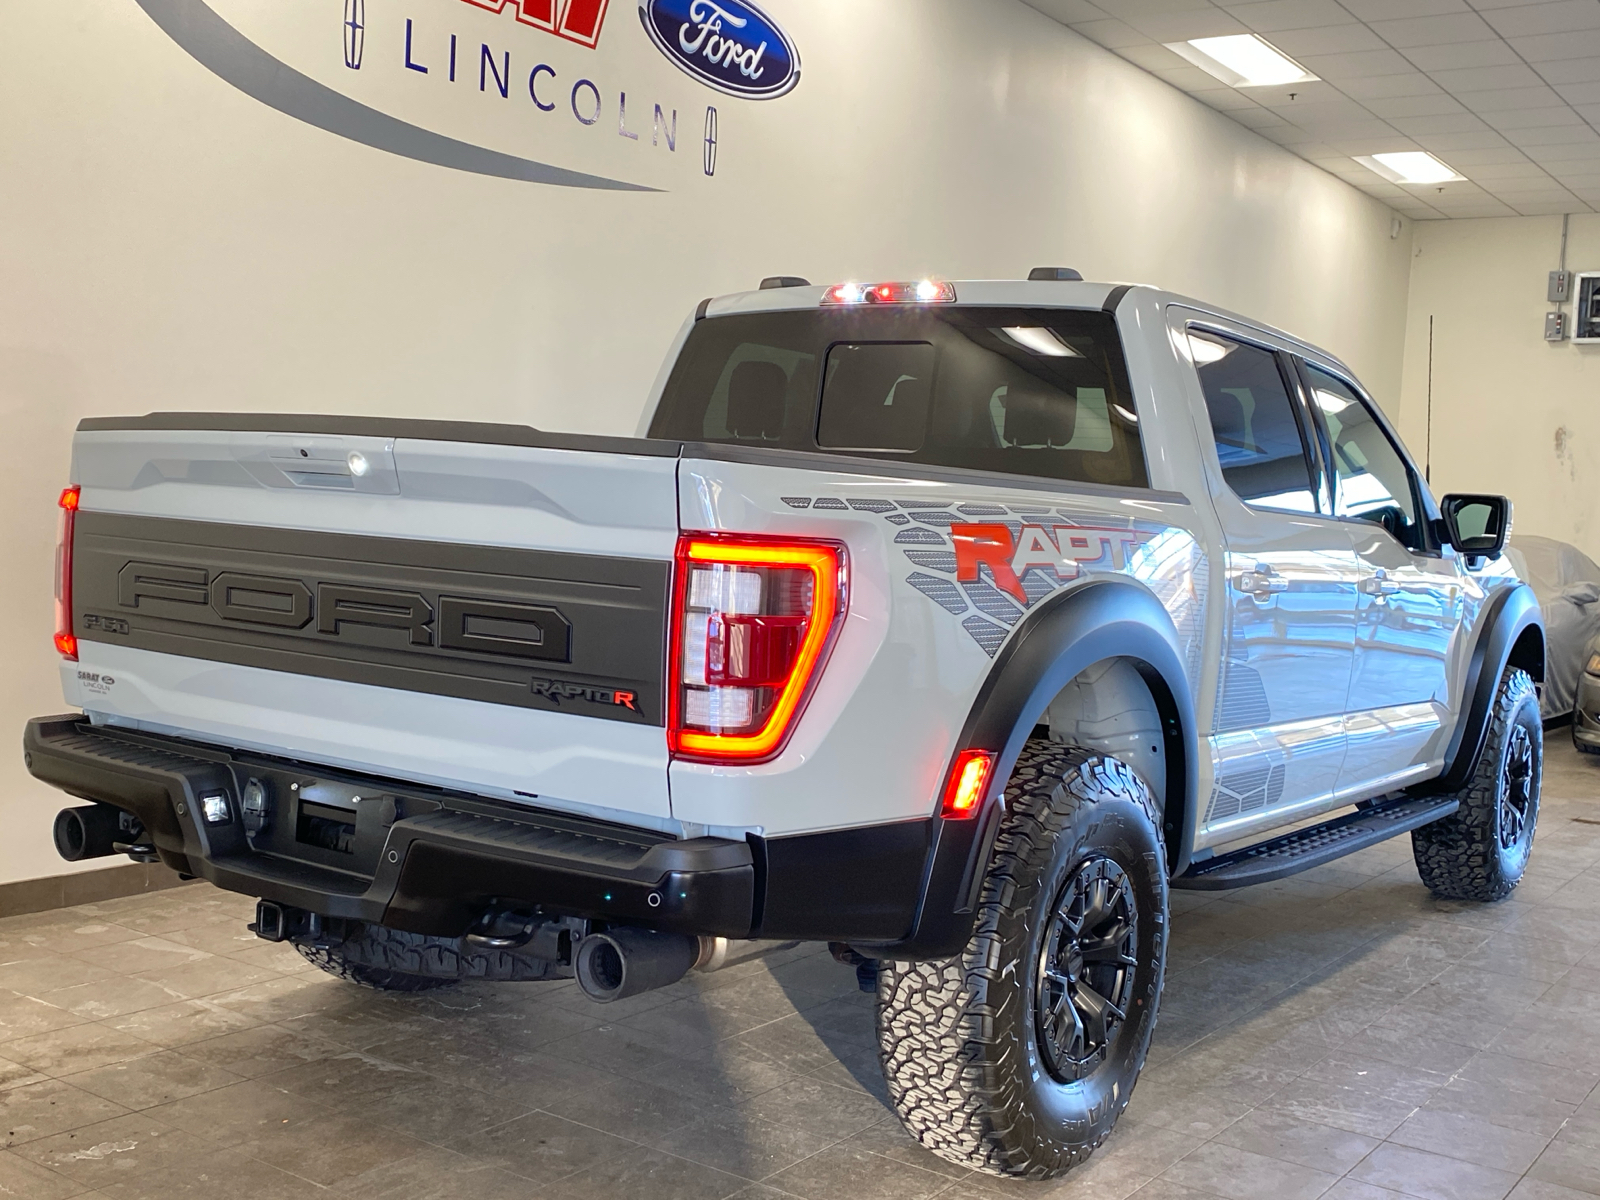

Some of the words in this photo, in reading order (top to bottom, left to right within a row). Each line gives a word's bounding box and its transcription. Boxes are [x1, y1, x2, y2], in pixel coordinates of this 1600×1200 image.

[679, 0, 767, 80] Ford
[405, 18, 677, 152] LINCOLN
[118, 560, 573, 664] FORD
[83, 681, 110, 691] LINCOLN
[530, 676, 645, 717] RAPTOR
